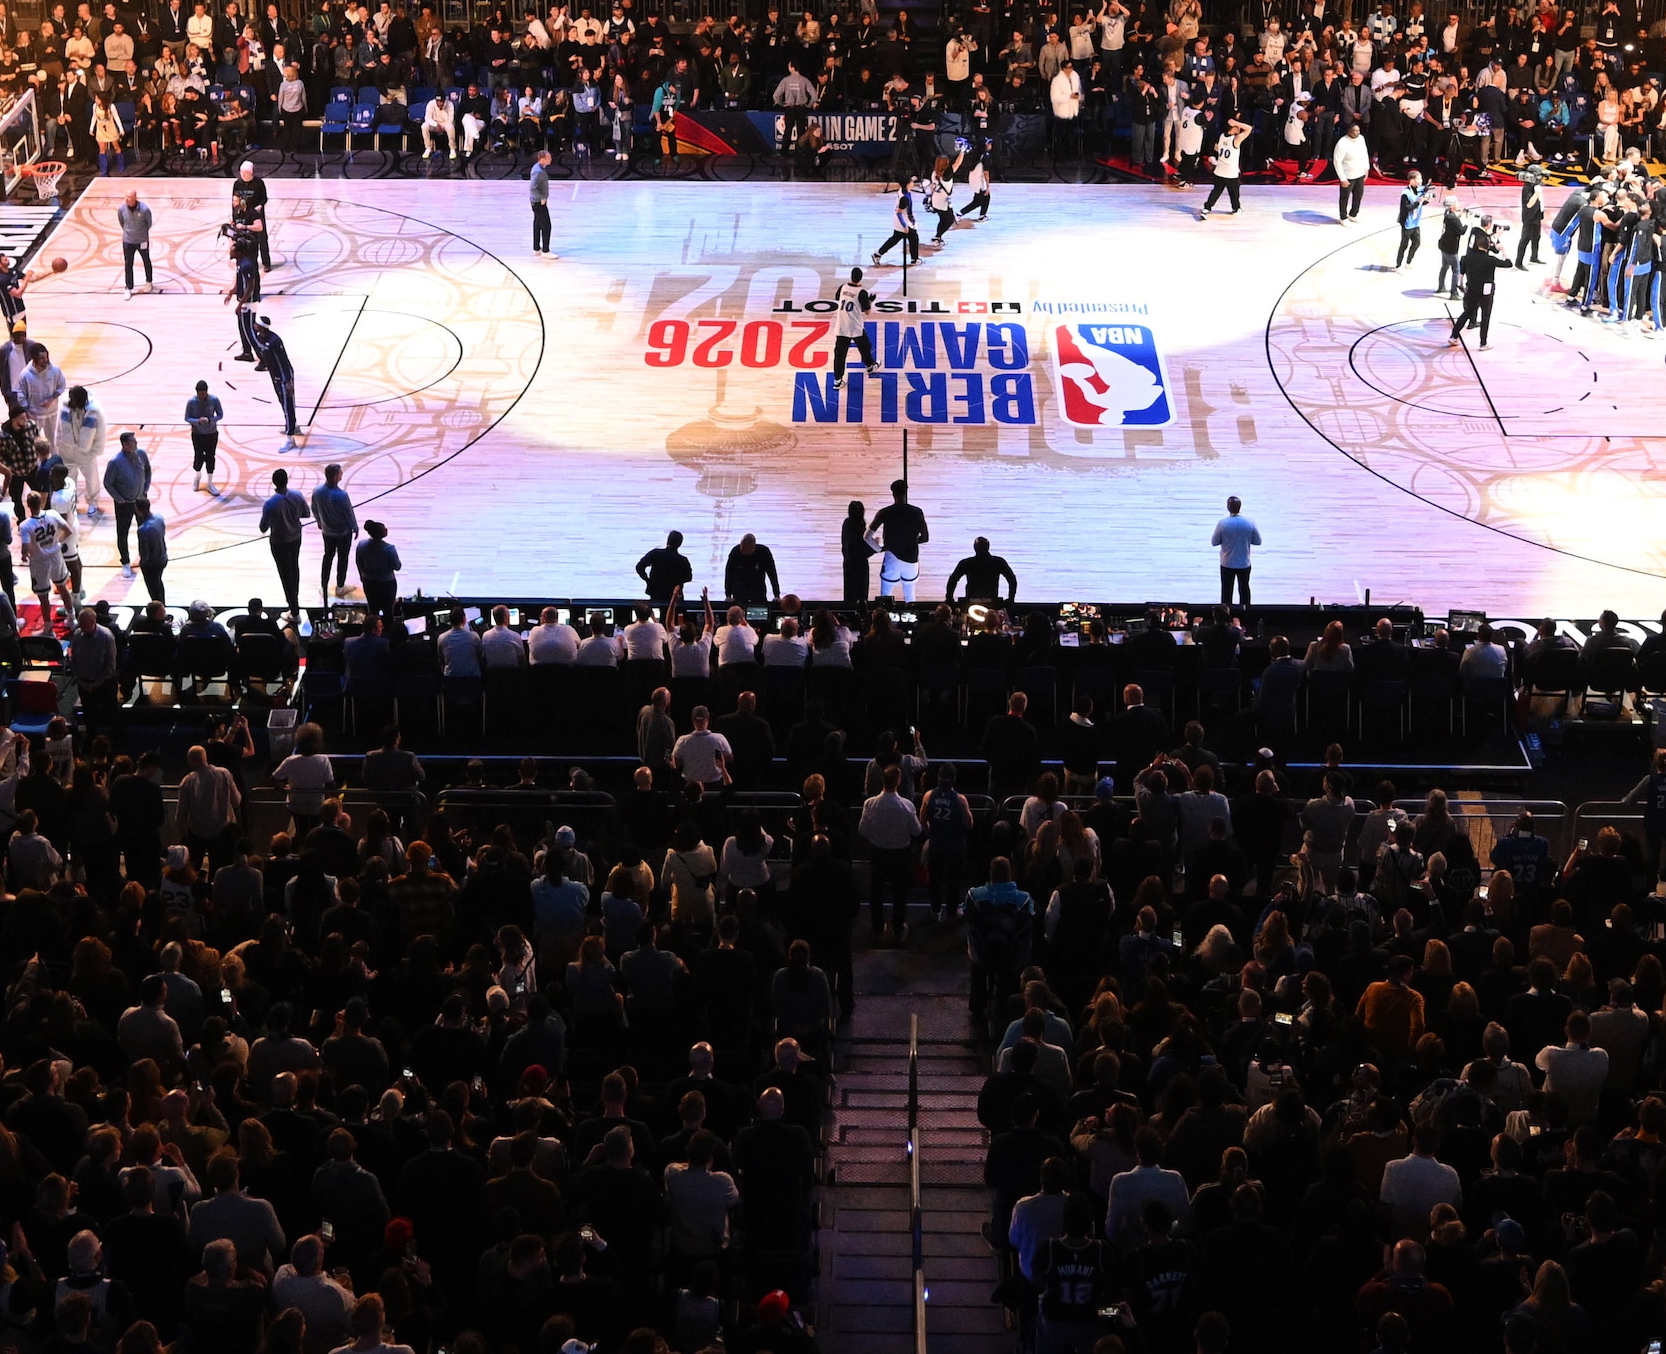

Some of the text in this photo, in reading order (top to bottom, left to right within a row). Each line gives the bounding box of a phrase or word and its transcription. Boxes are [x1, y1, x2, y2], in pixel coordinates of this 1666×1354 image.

[844, 115, 886, 142] GAME
[772, 299, 951, 314] TISOT
[840, 299, 854, 313] 10
[1033, 298, 1149, 316] Presented by
[644, 319, 830, 369] 2026
[1091, 326, 1143, 345] NBA
[791, 371, 1037, 425] BERLIN
[34, 523, 56, 543] 24
[932, 806, 952, 821] 22
[1056, 1264, 1096, 1278] MORANT
